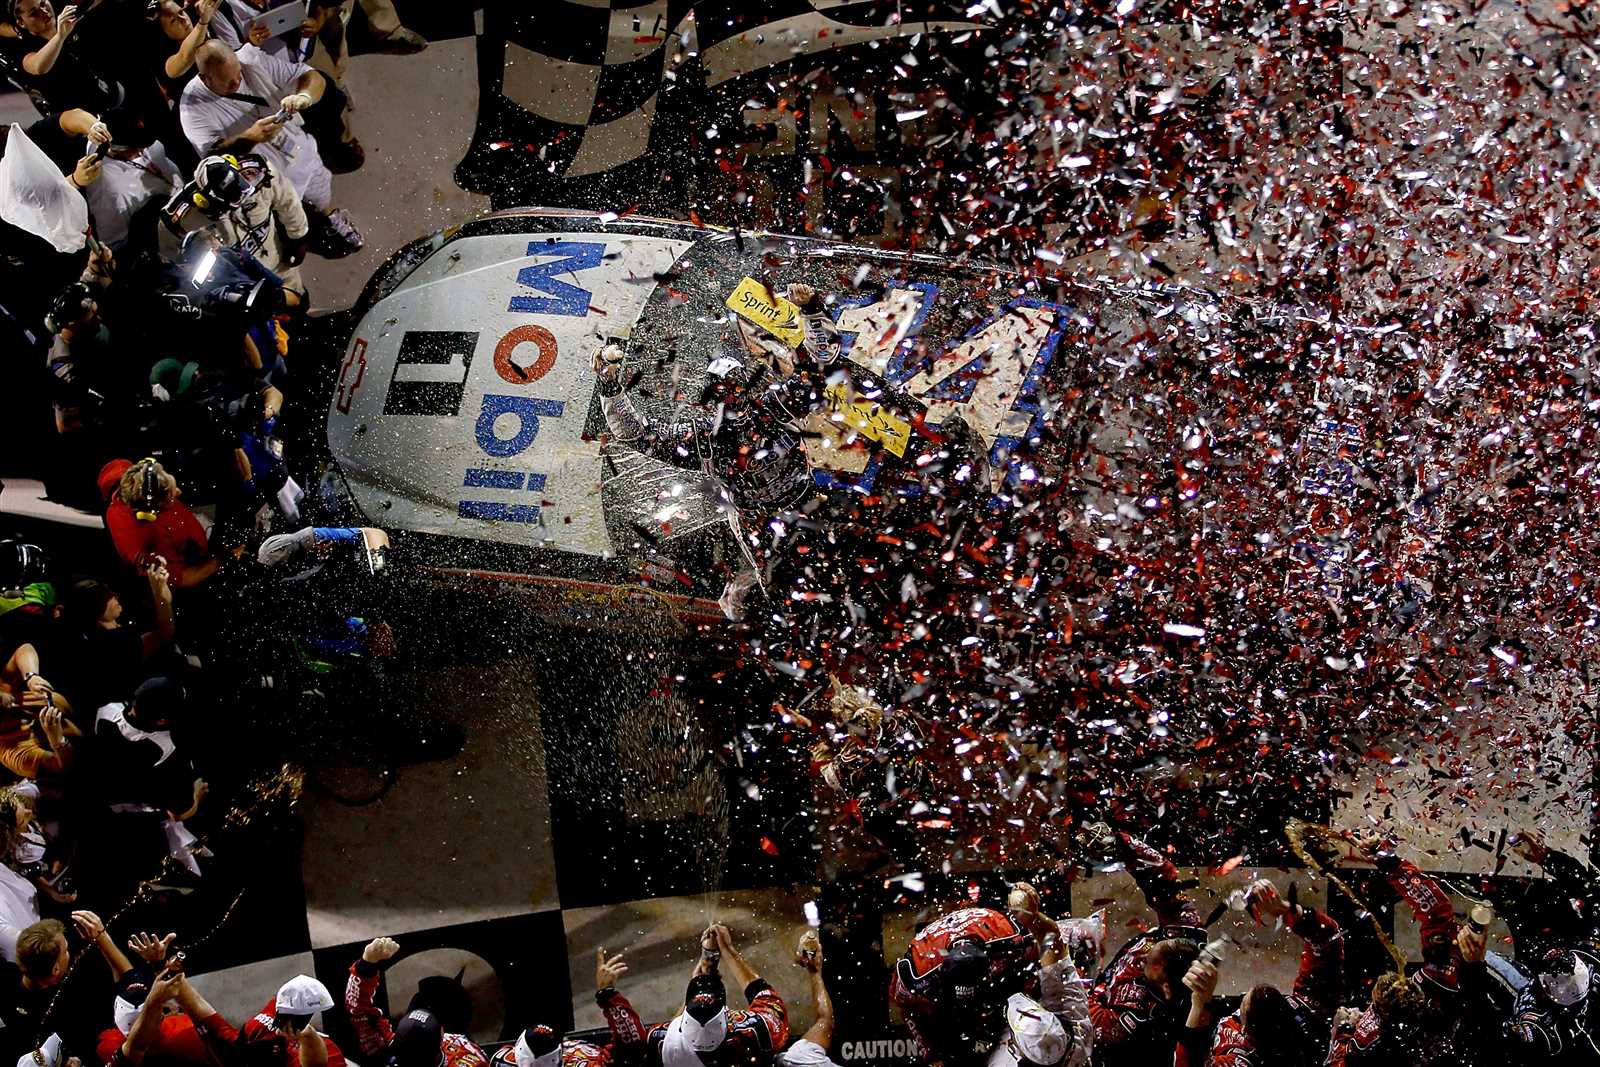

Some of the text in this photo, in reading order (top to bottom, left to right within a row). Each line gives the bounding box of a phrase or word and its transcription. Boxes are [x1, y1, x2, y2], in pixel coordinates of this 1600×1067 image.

[739, 291, 781, 321] Sprint
[459, 240, 607, 524] Mobil
[1406, 869, 1439, 908] DEPO
[841, 1039, 918, 1060] CAUTION
